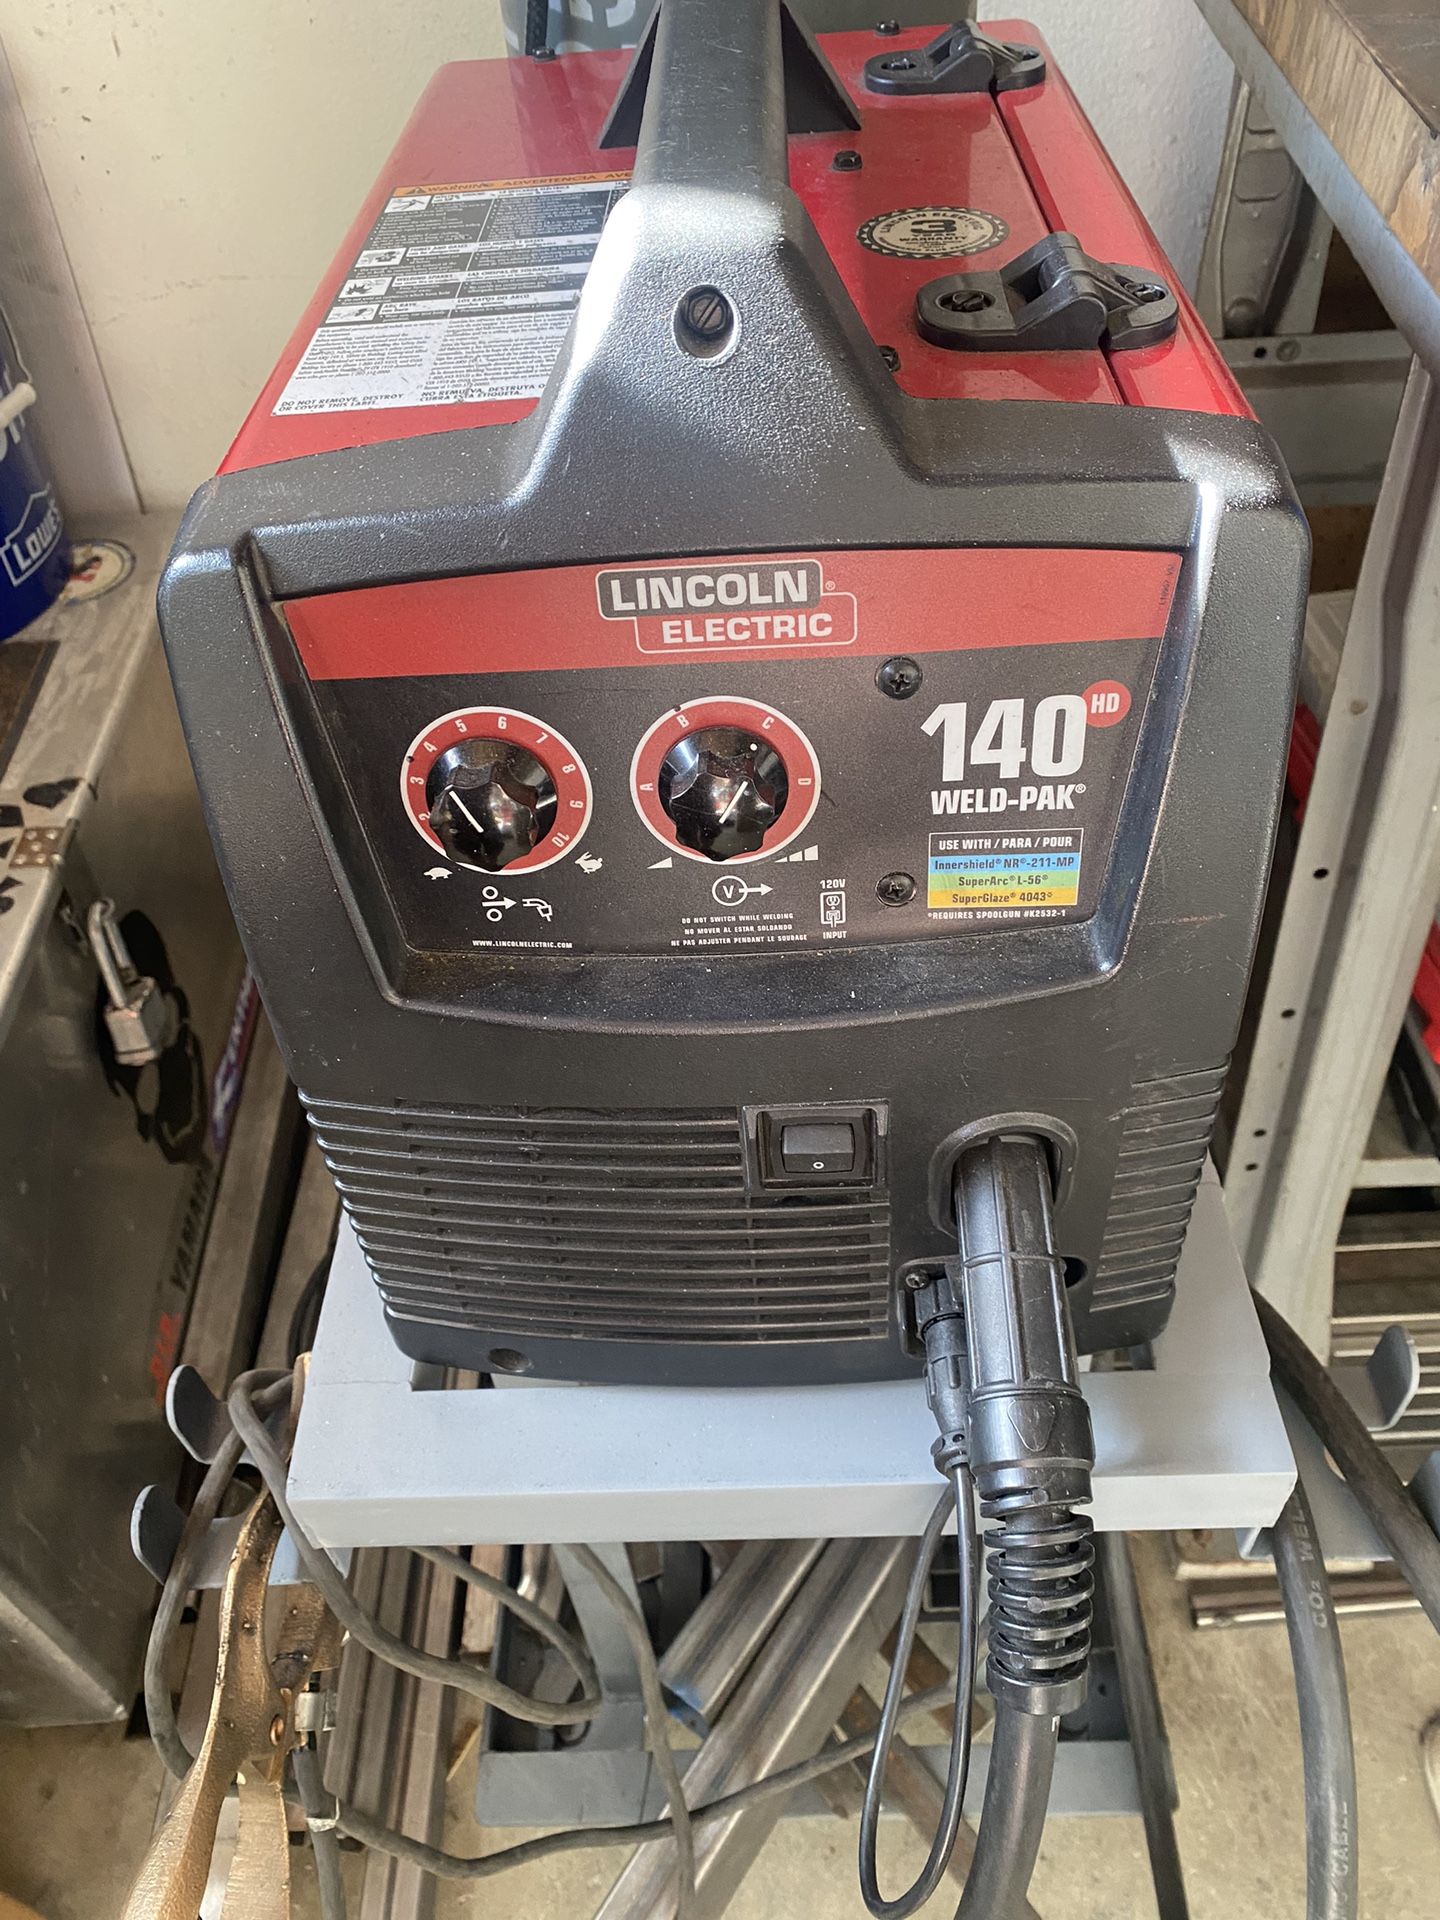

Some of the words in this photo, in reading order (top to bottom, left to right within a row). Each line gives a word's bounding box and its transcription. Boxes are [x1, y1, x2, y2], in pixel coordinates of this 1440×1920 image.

[427, 181, 494, 192] WARNING
[503, 174, 597, 186] ADVERTENCIA
[880, 213, 926, 233] LINCOLN
[911, 219, 957, 233] 3
[488, 384, 535, 392] DESTRUYA
[319, 396, 360, 404] REMOVE,
[610, 569, 808, 611] LINCOLN
[662, 613, 833, 643] ELECTRIC
[455, 719, 467, 733] 5
[497, 716, 507, 729] 6
[536, 732, 549, 744] 7
[920, 694, 1087, 781] 140
[1091, 693, 1120, 713] HD
[423, 741, 437, 753] 4
[640, 783, 654, 791] A
[676, 714, 689, 728] B
[762, 716, 774, 729] C
[797, 778, 811, 786] D
[562, 763, 576, 774] 8
[410, 776, 425, 785] 3
[552, 832, 570, 847] 10
[939, 840, 959, 850] USE
[962, 838, 991, 849] WITH
[1002, 837, 1032, 848] PARA
[1042, 836, 1072, 847] POUR
[820, 878, 846, 889] 120V
[722, 885, 734, 899] V
[1024, 910, 1066, 918] #K2532-1
[822, 931, 847, 940] INPUT
[472, 939, 573, 949] WWW.LINCOLNELECTRIC.COM
